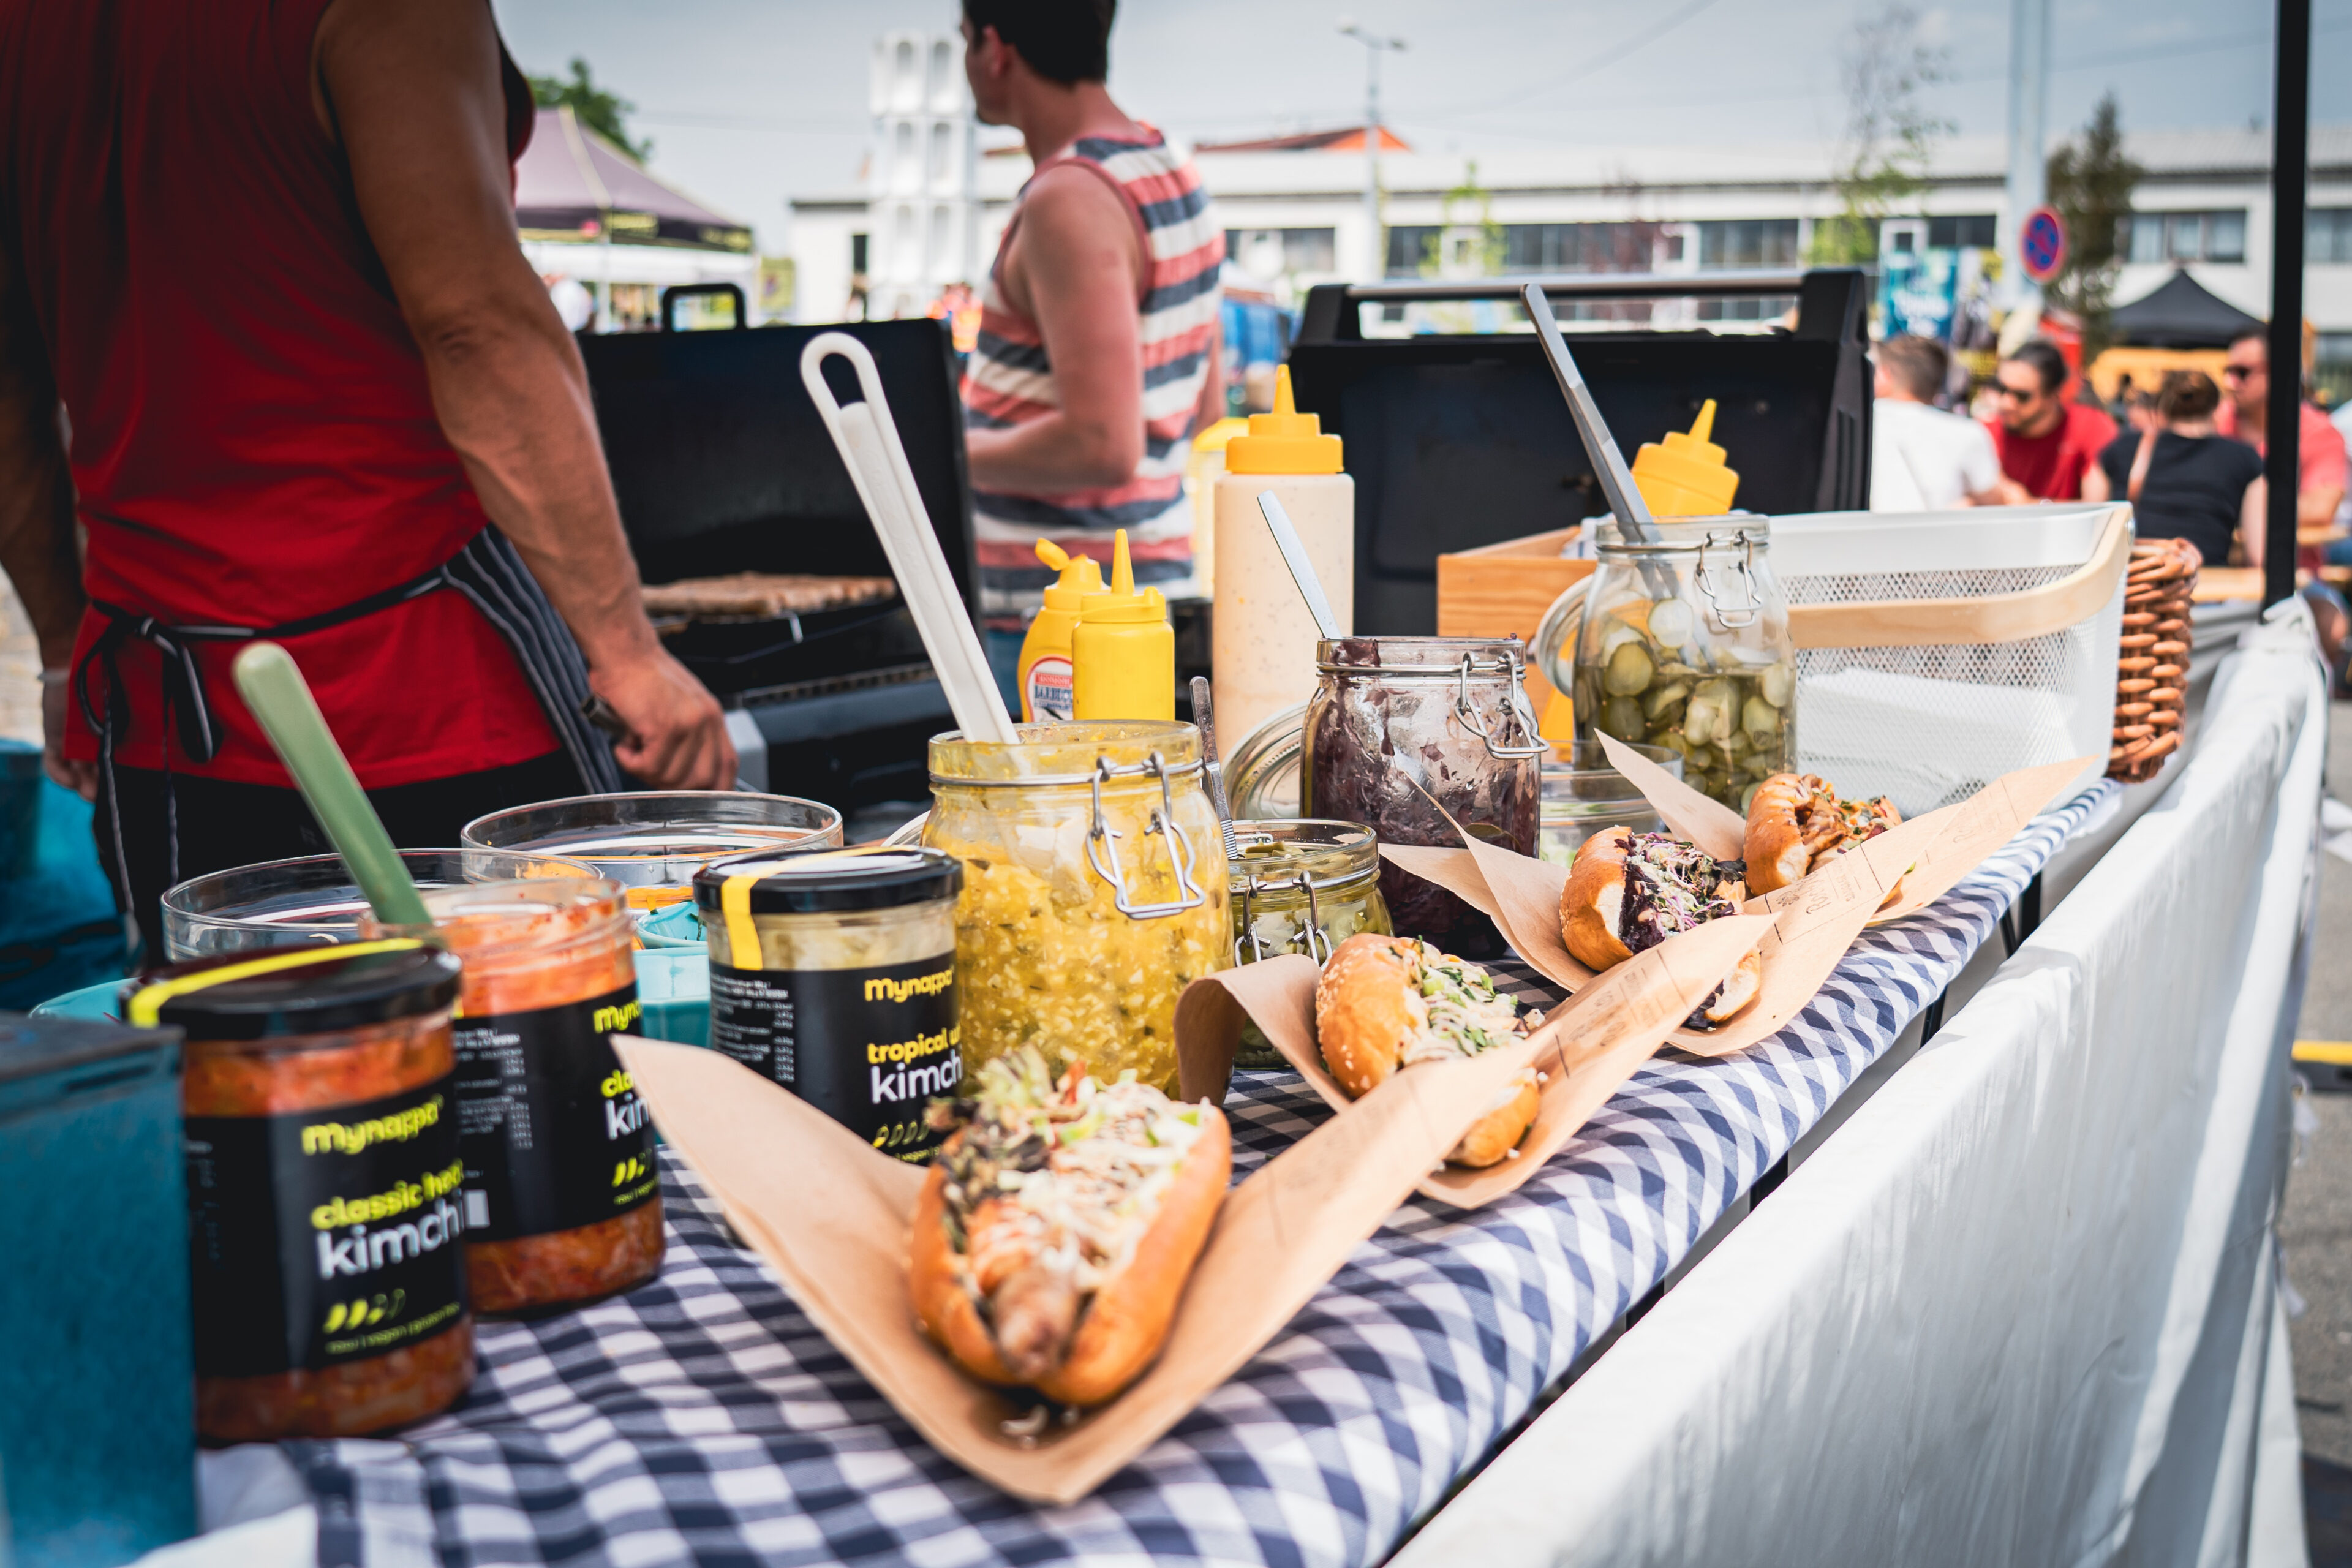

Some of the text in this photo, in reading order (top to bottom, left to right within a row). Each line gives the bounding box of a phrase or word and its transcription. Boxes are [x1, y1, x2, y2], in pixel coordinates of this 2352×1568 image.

[864, 969, 953, 1003] mynappa
[867, 1027, 948, 1065] tropical
[302, 1102, 439, 1155] mynappa
[311, 1180, 424, 1230] classic
[317, 1187, 464, 1279] kimchi
